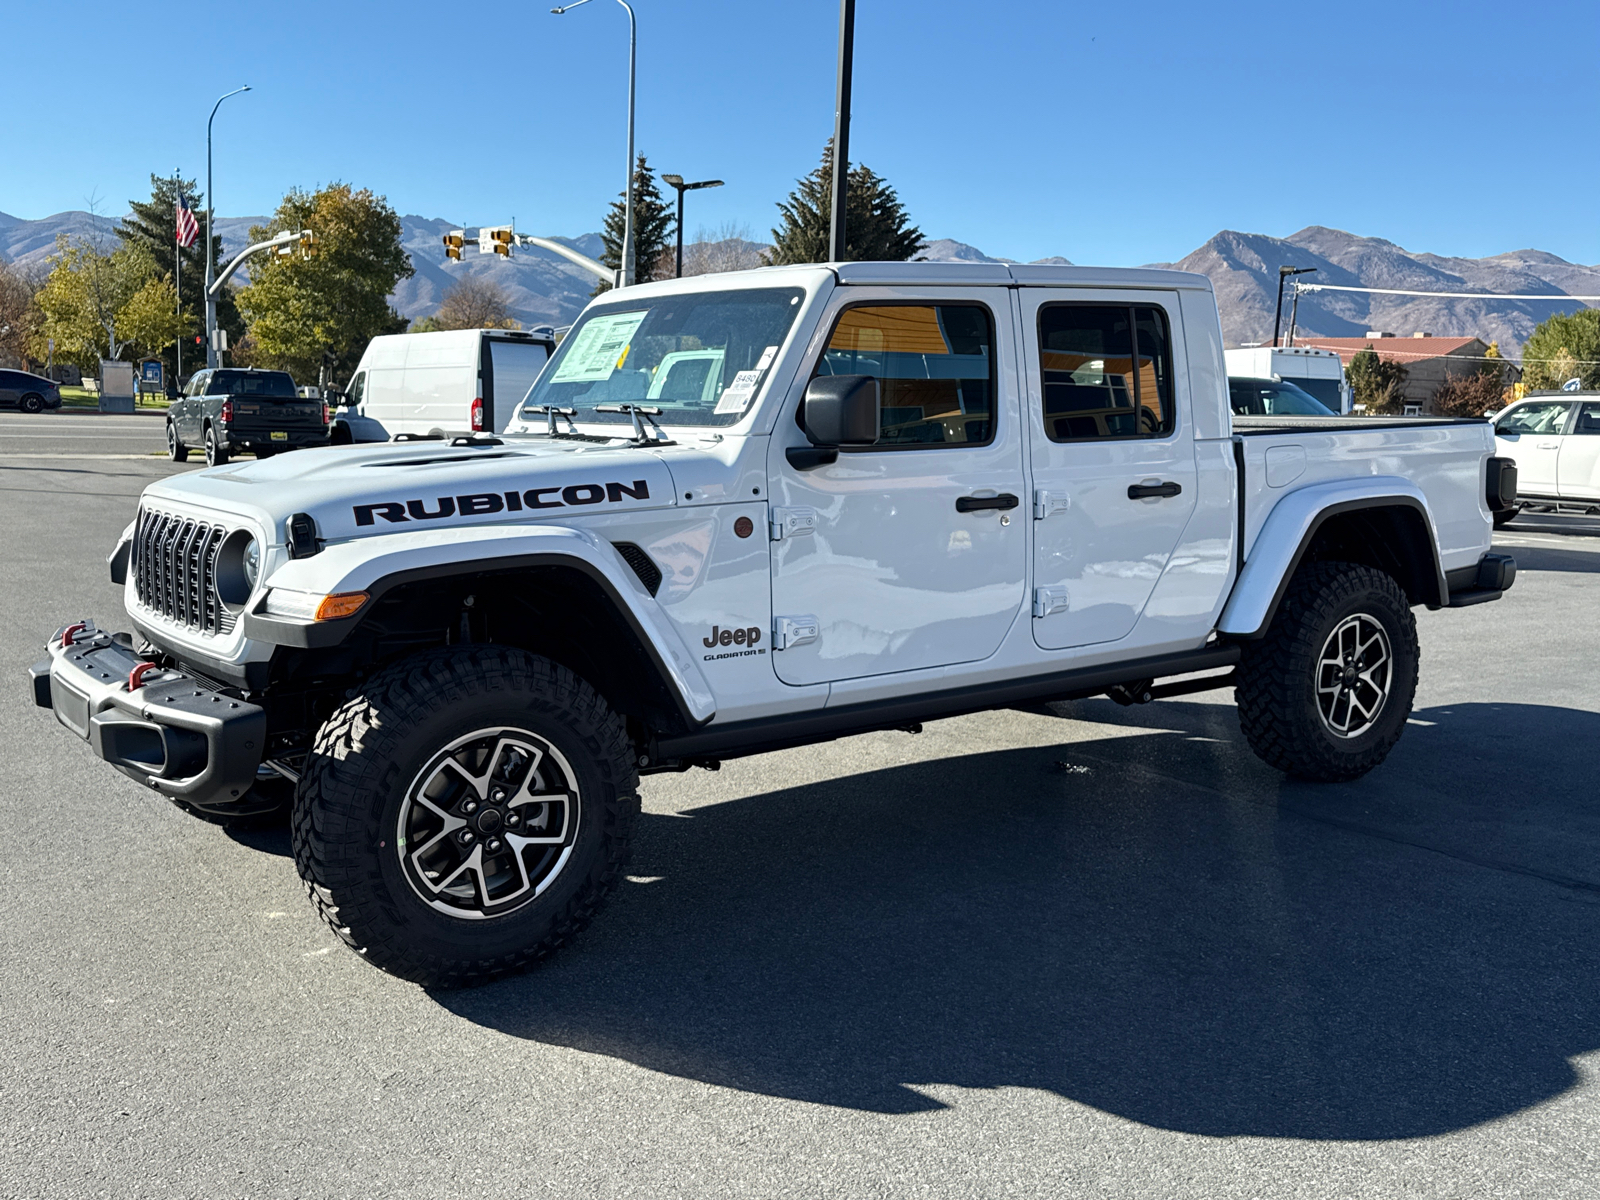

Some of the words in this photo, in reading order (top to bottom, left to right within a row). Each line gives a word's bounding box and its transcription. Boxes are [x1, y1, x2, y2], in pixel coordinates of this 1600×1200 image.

[736, 374, 757, 383] 8480
[353, 480, 650, 526] RUBICON
[703, 625, 761, 649] Jeep
[703, 649, 757, 661] GLADIATOR
[526, 697, 618, 853] WILDPEAK
[366, 761, 409, 927] FALKEN
